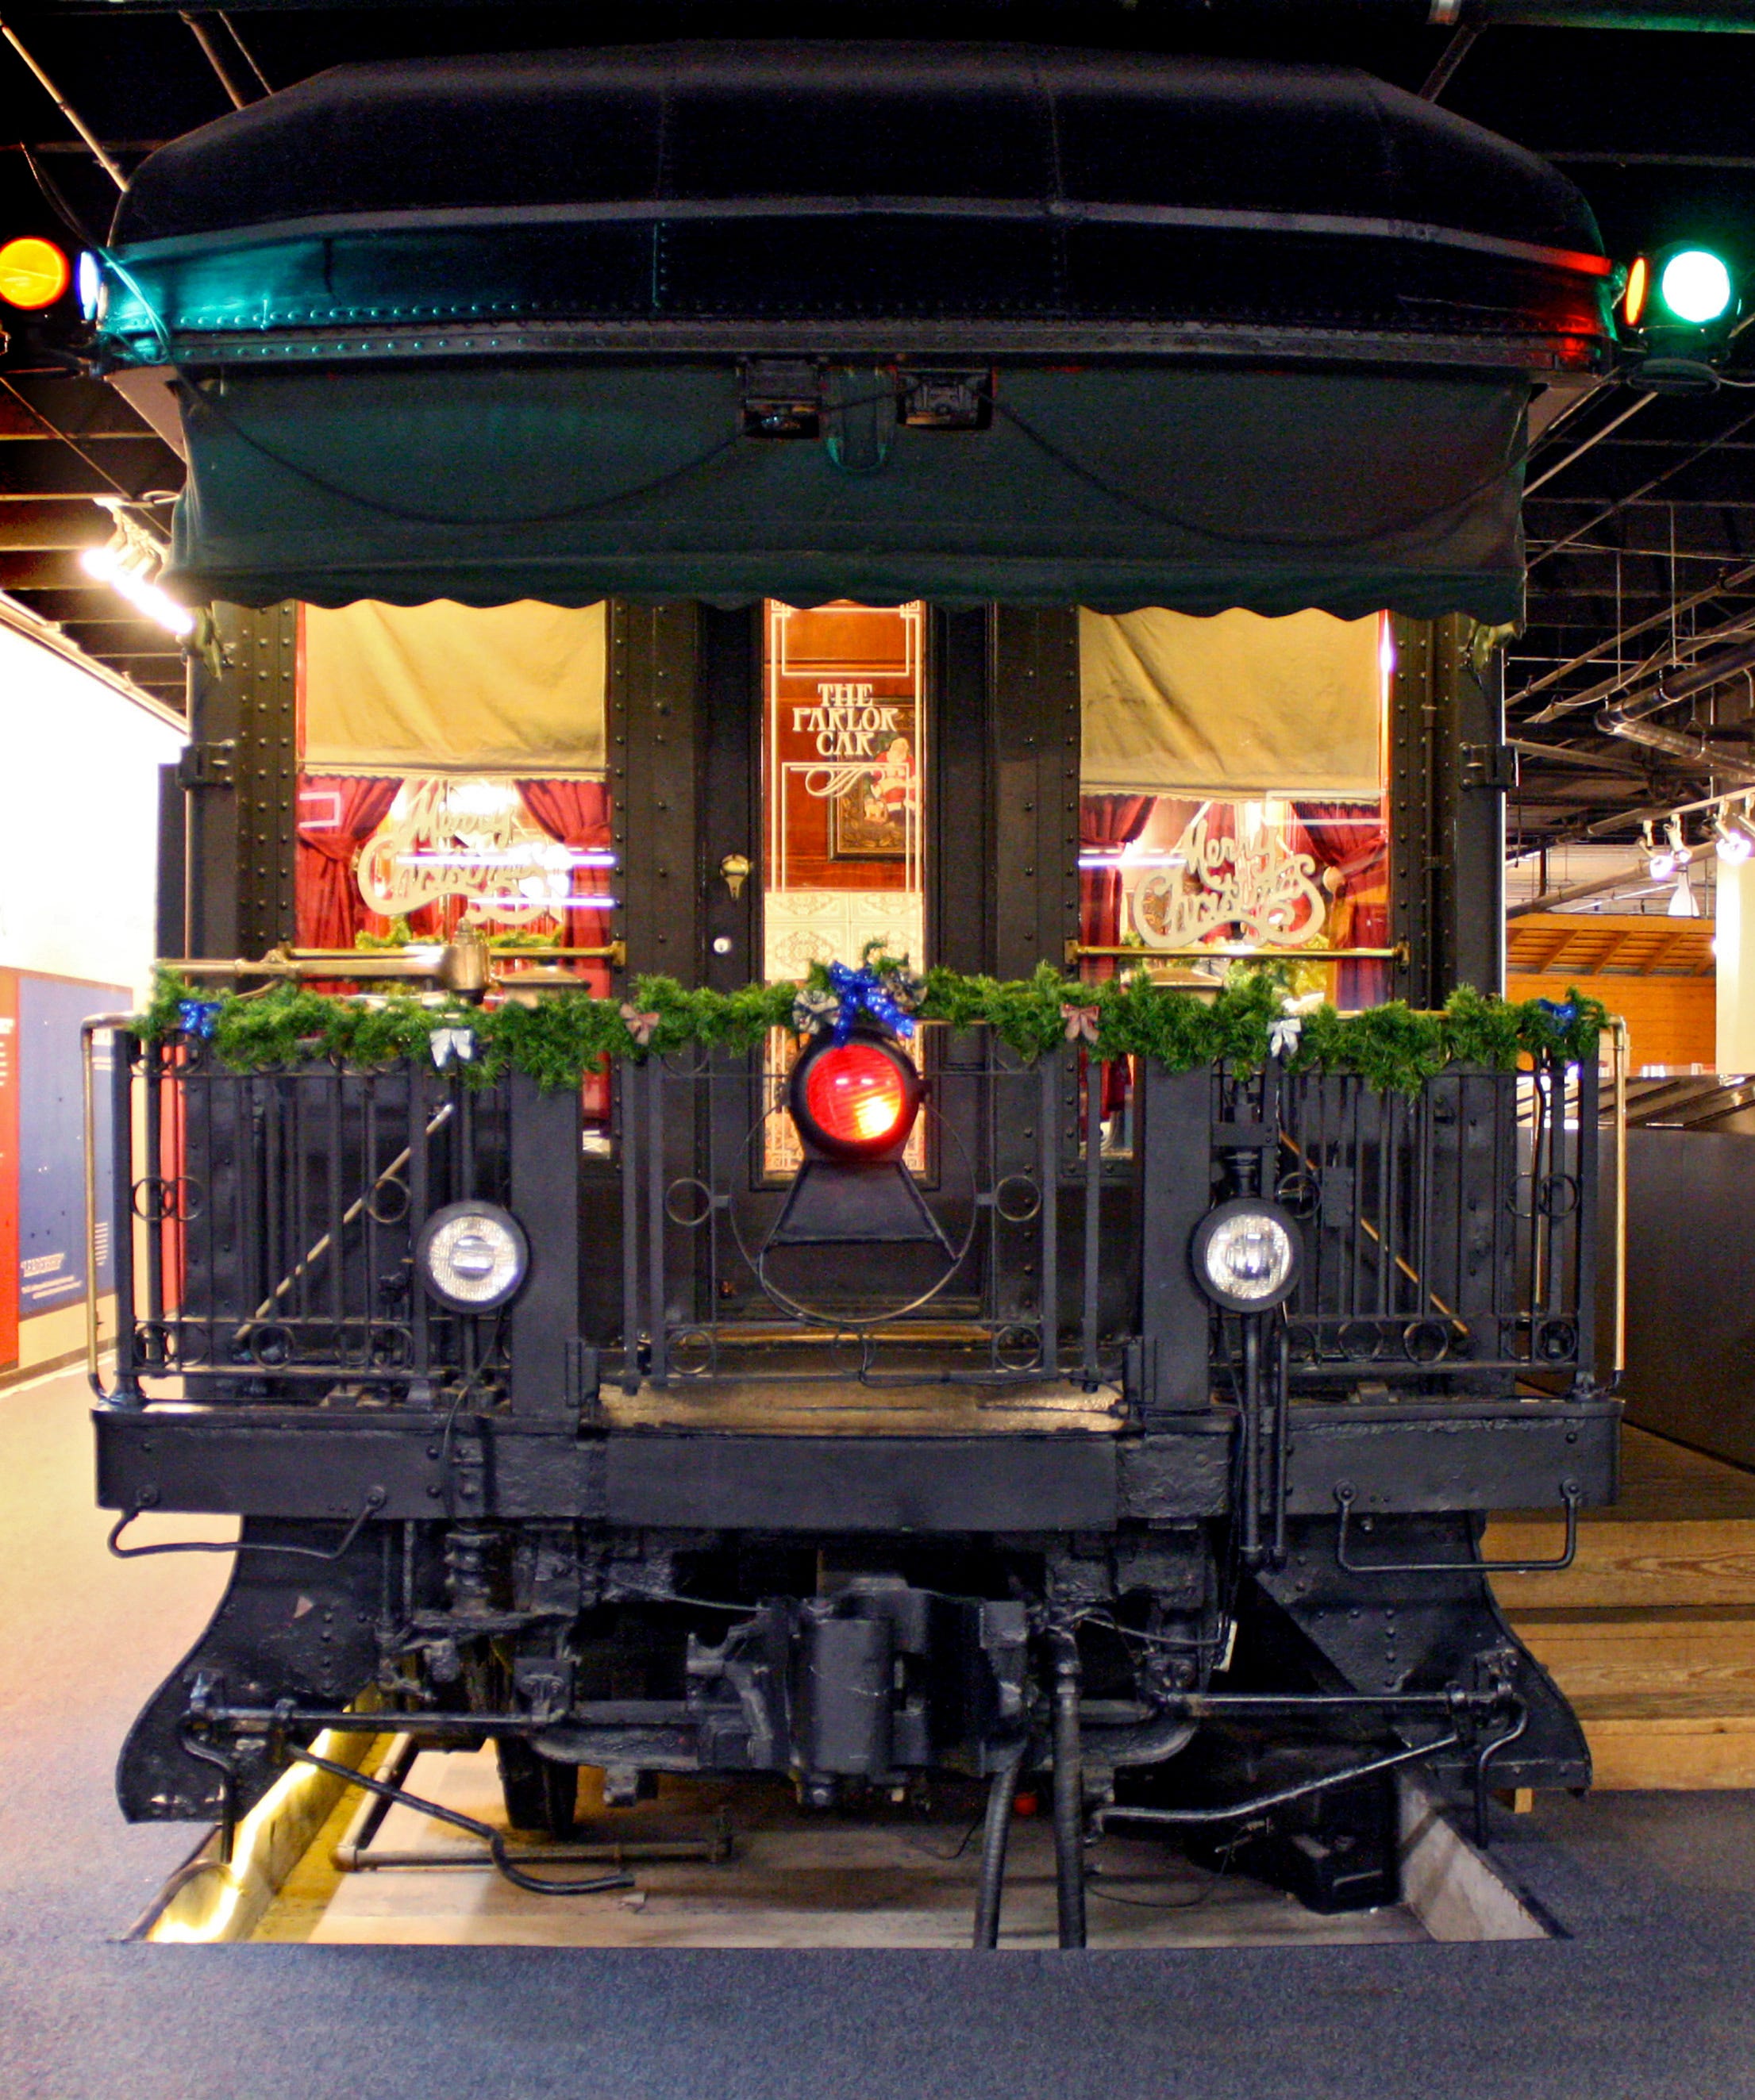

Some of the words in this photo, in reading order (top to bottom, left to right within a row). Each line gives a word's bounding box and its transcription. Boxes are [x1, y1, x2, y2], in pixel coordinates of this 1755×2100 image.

[818, 683, 873, 707] THE
[792, 706, 899, 732] PARLOR
[815, 731, 875, 756] CAR
[1183, 818, 1279, 881] Merry
[1133, 854, 1326, 948] Christmas
